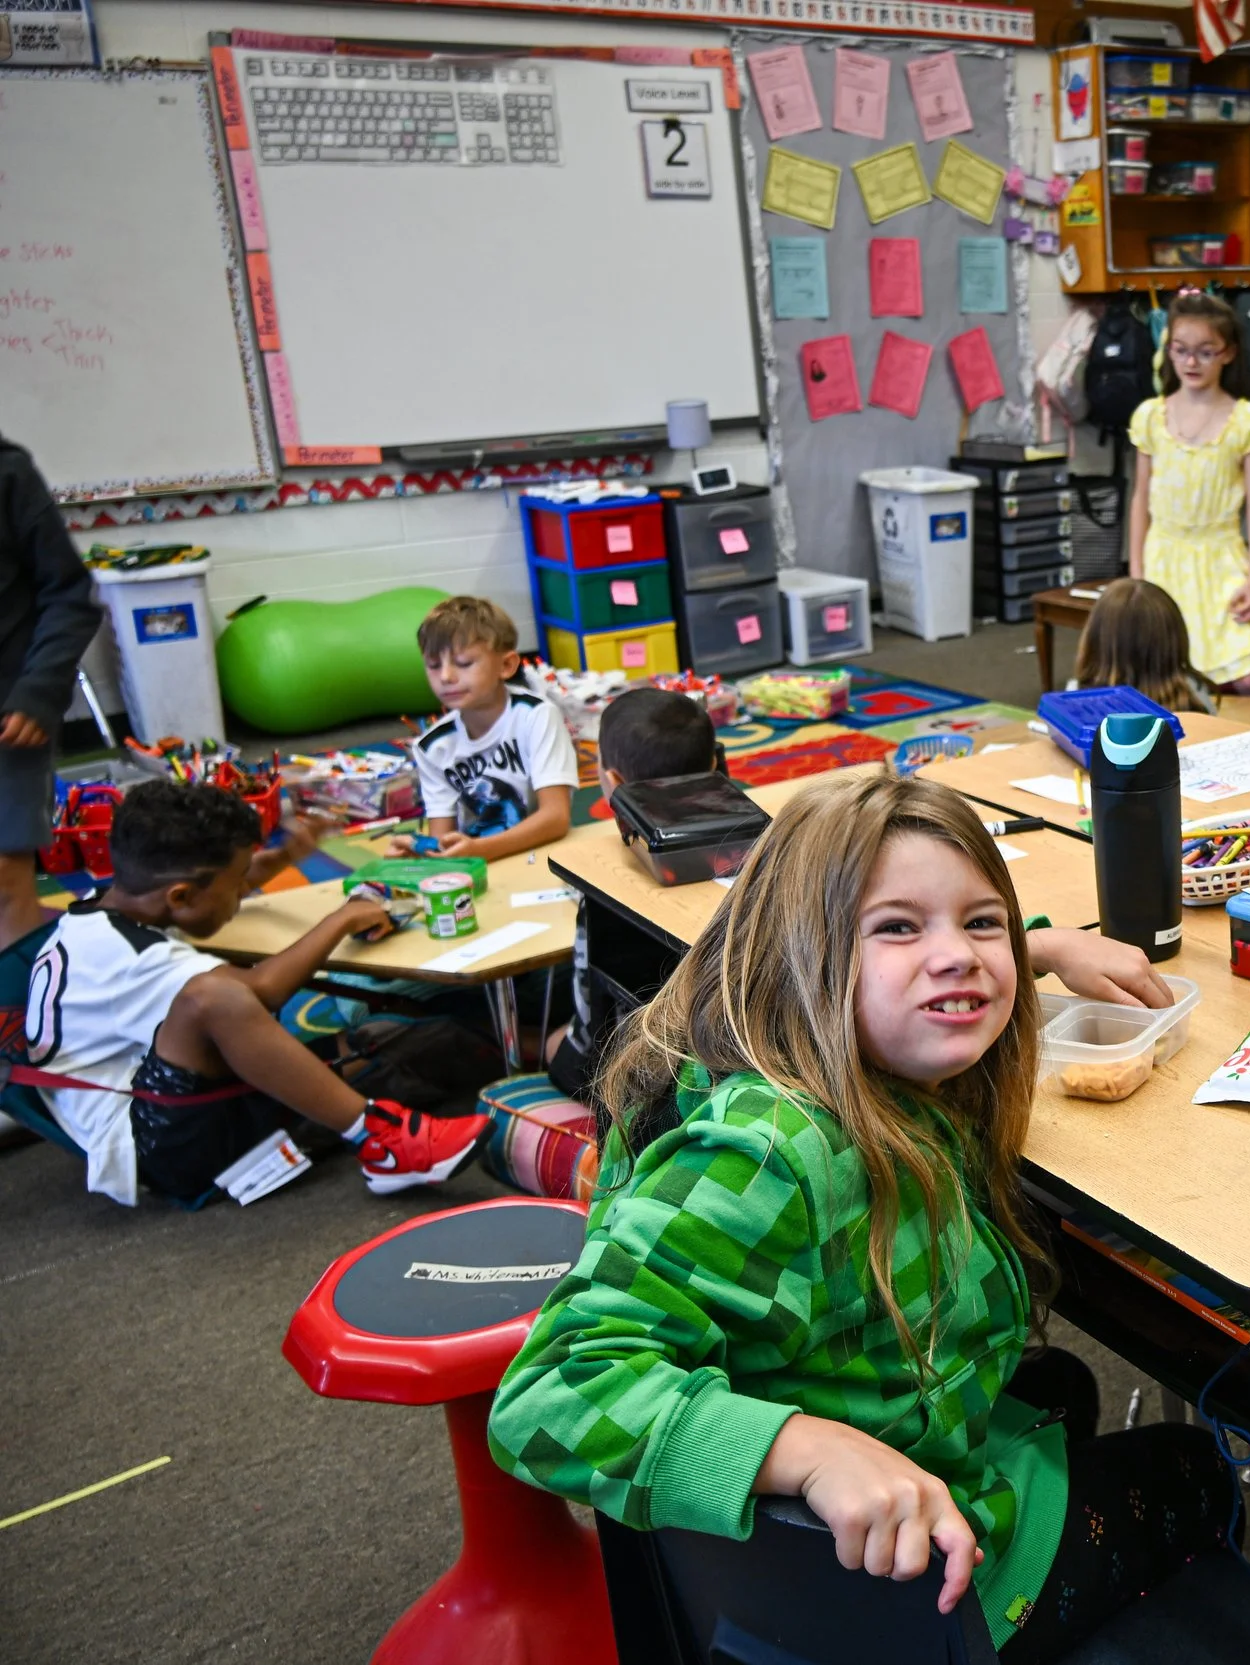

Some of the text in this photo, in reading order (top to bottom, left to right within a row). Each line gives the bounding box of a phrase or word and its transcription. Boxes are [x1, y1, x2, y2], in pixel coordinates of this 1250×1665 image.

[636, 87, 700, 99] Voice Level
[663, 126, 690, 167] 2
[258, 275, 277, 336] Perimeter
[298, 446, 356, 463] Perimeter
